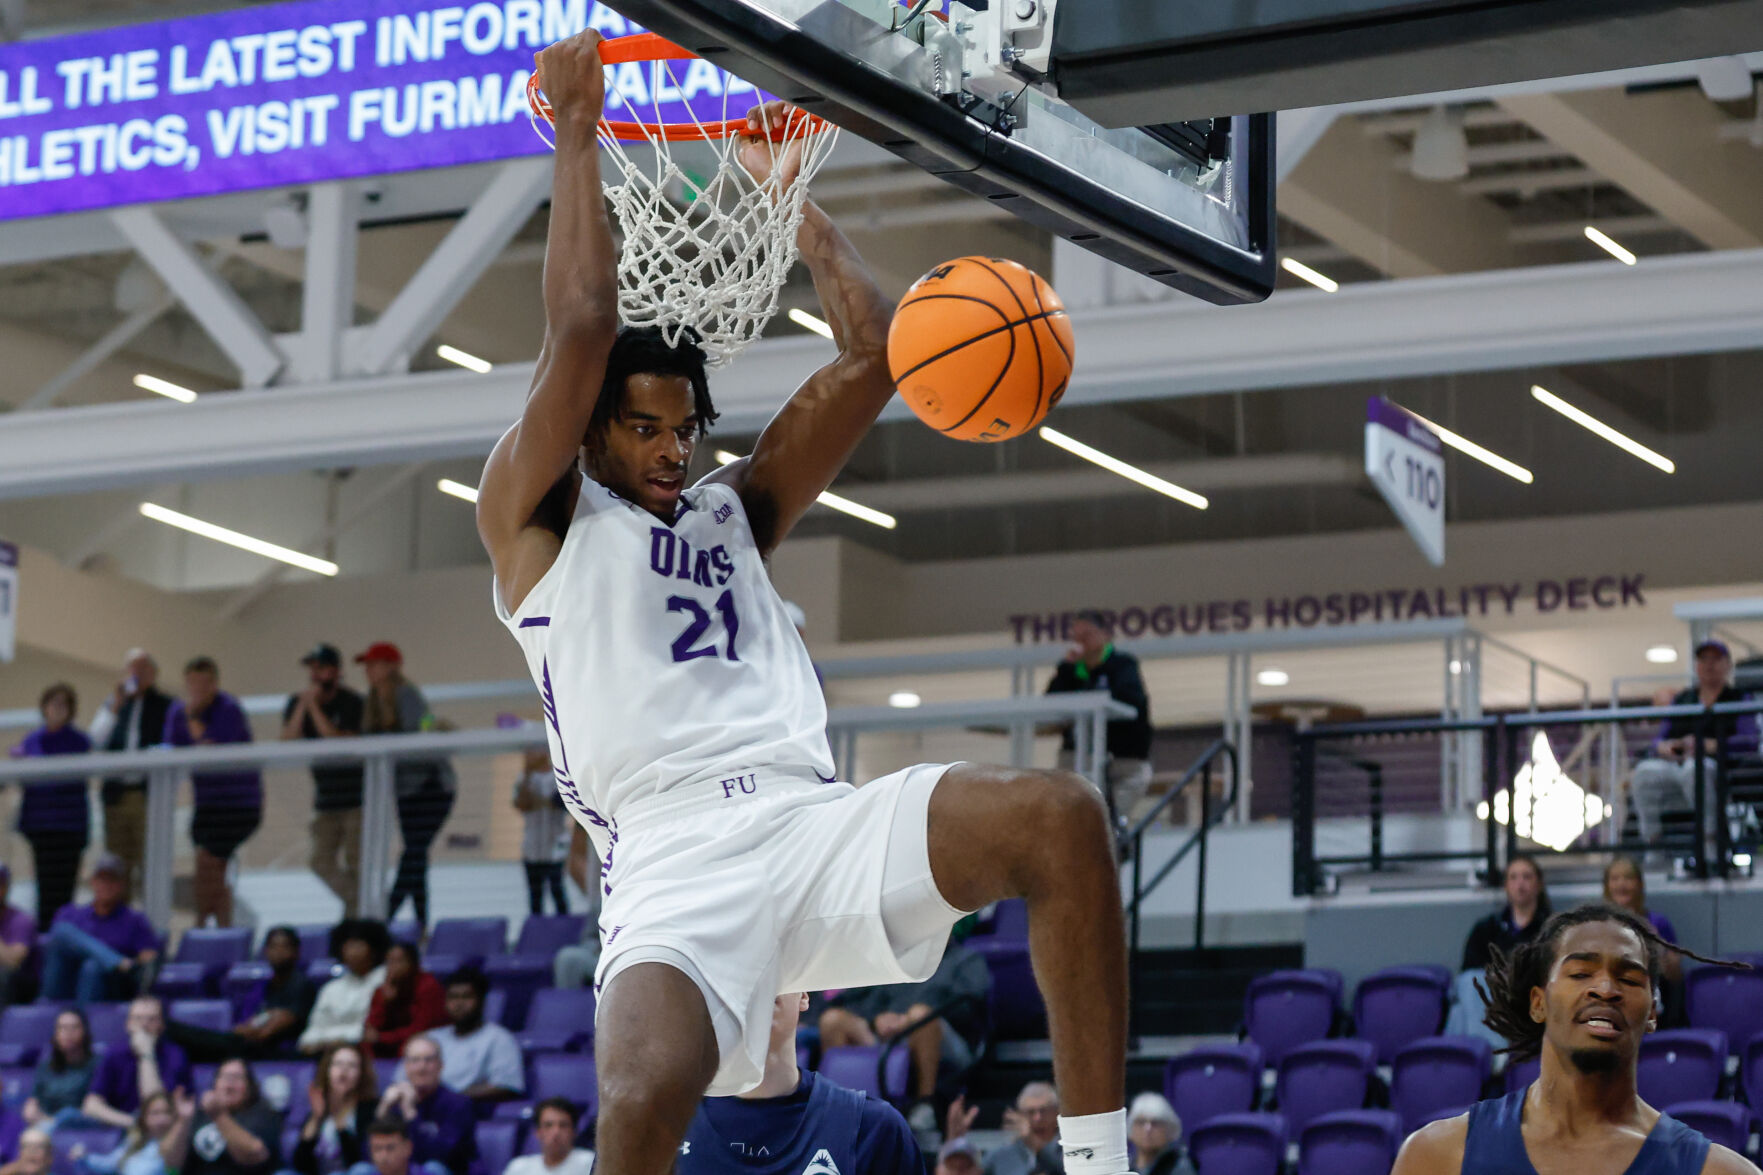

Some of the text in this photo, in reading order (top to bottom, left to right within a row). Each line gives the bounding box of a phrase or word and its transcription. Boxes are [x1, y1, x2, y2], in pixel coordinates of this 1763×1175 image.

[56, 48, 160, 109] THE
[168, 20, 367, 95] LATEST
[375, 0, 647, 67] INFORMA
[206, 94, 339, 158] VISIT
[1405, 455, 1440, 510] 110
[666, 589, 743, 663] 21
[1010, 610, 1077, 643] THE
[1265, 583, 1521, 628] HOSPITALITY
[1535, 574, 1646, 612] DECK
[719, 773, 756, 799] FU
